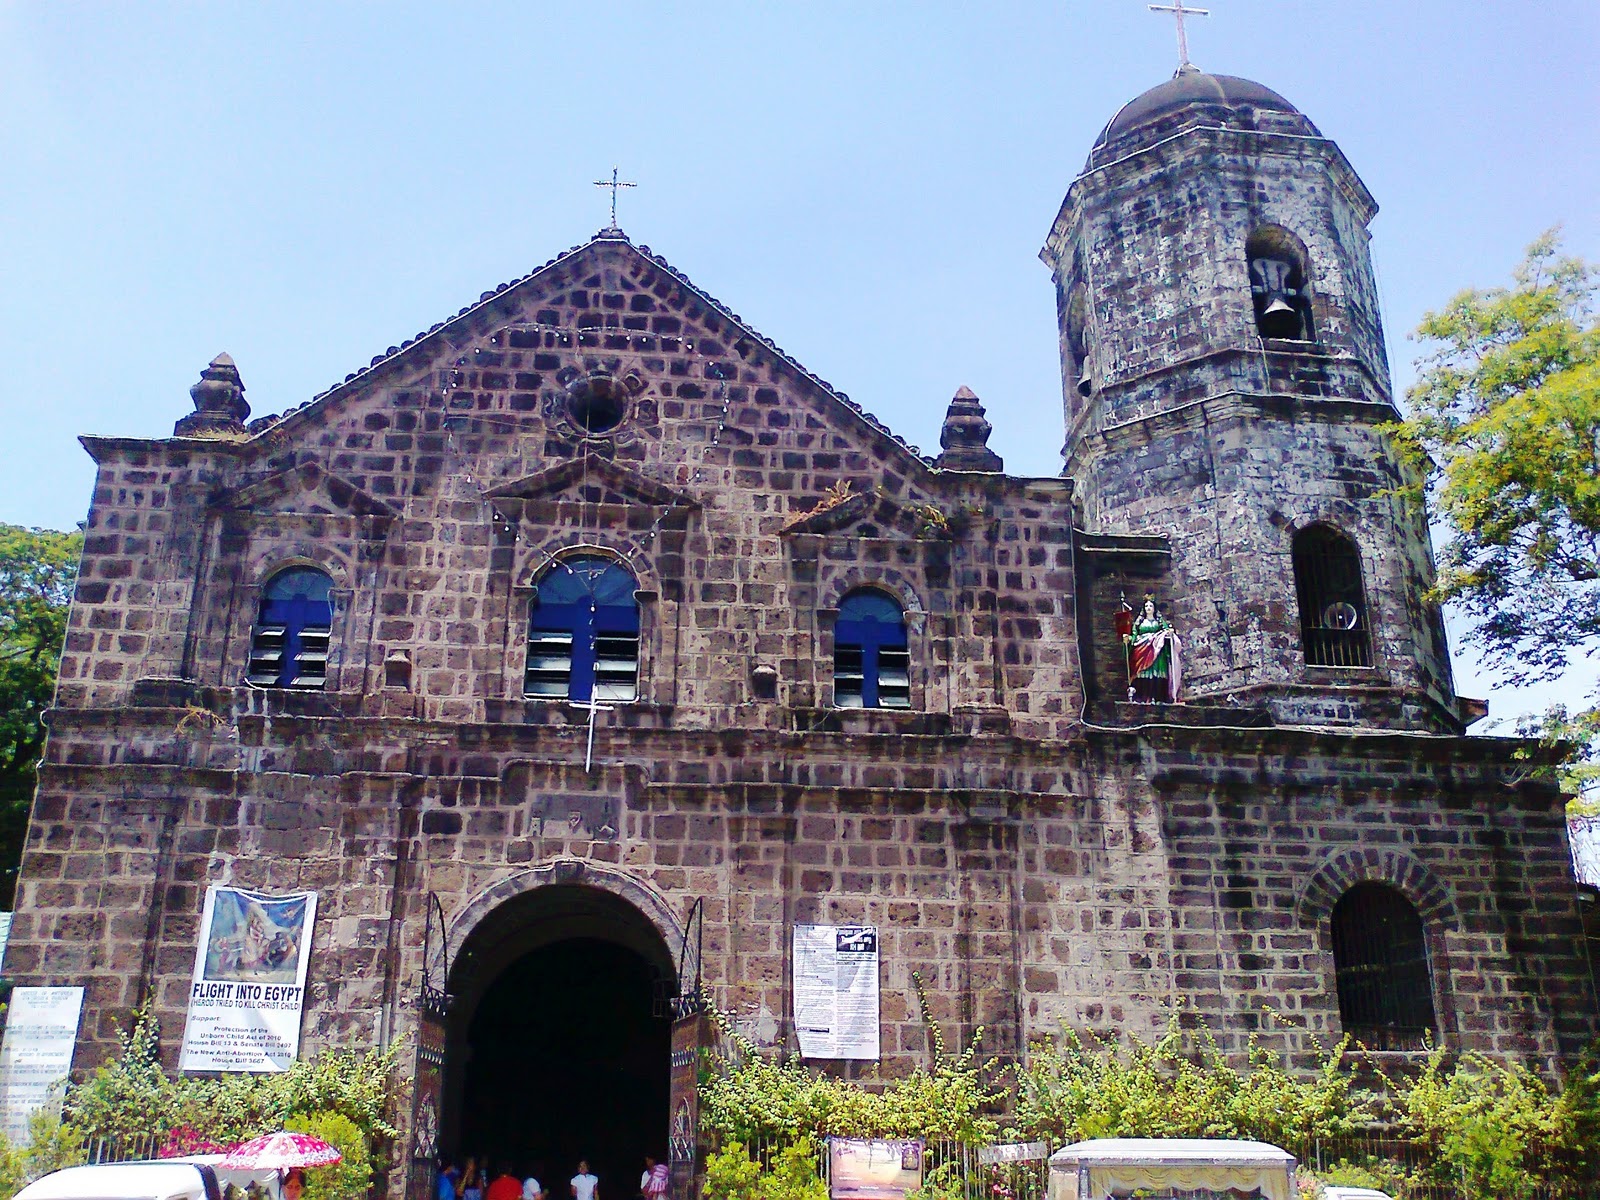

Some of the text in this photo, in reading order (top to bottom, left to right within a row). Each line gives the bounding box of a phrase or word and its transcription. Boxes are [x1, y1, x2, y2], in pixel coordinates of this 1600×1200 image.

[193, 983, 302, 1001] FLIGHT INTO EGYPT
[216, 1000, 234, 1008] TRIED
[235, 1000, 243, 1008] TO
[244, 1001, 255, 1009] KILL
[257, 1001, 279, 1010] CHRIST
